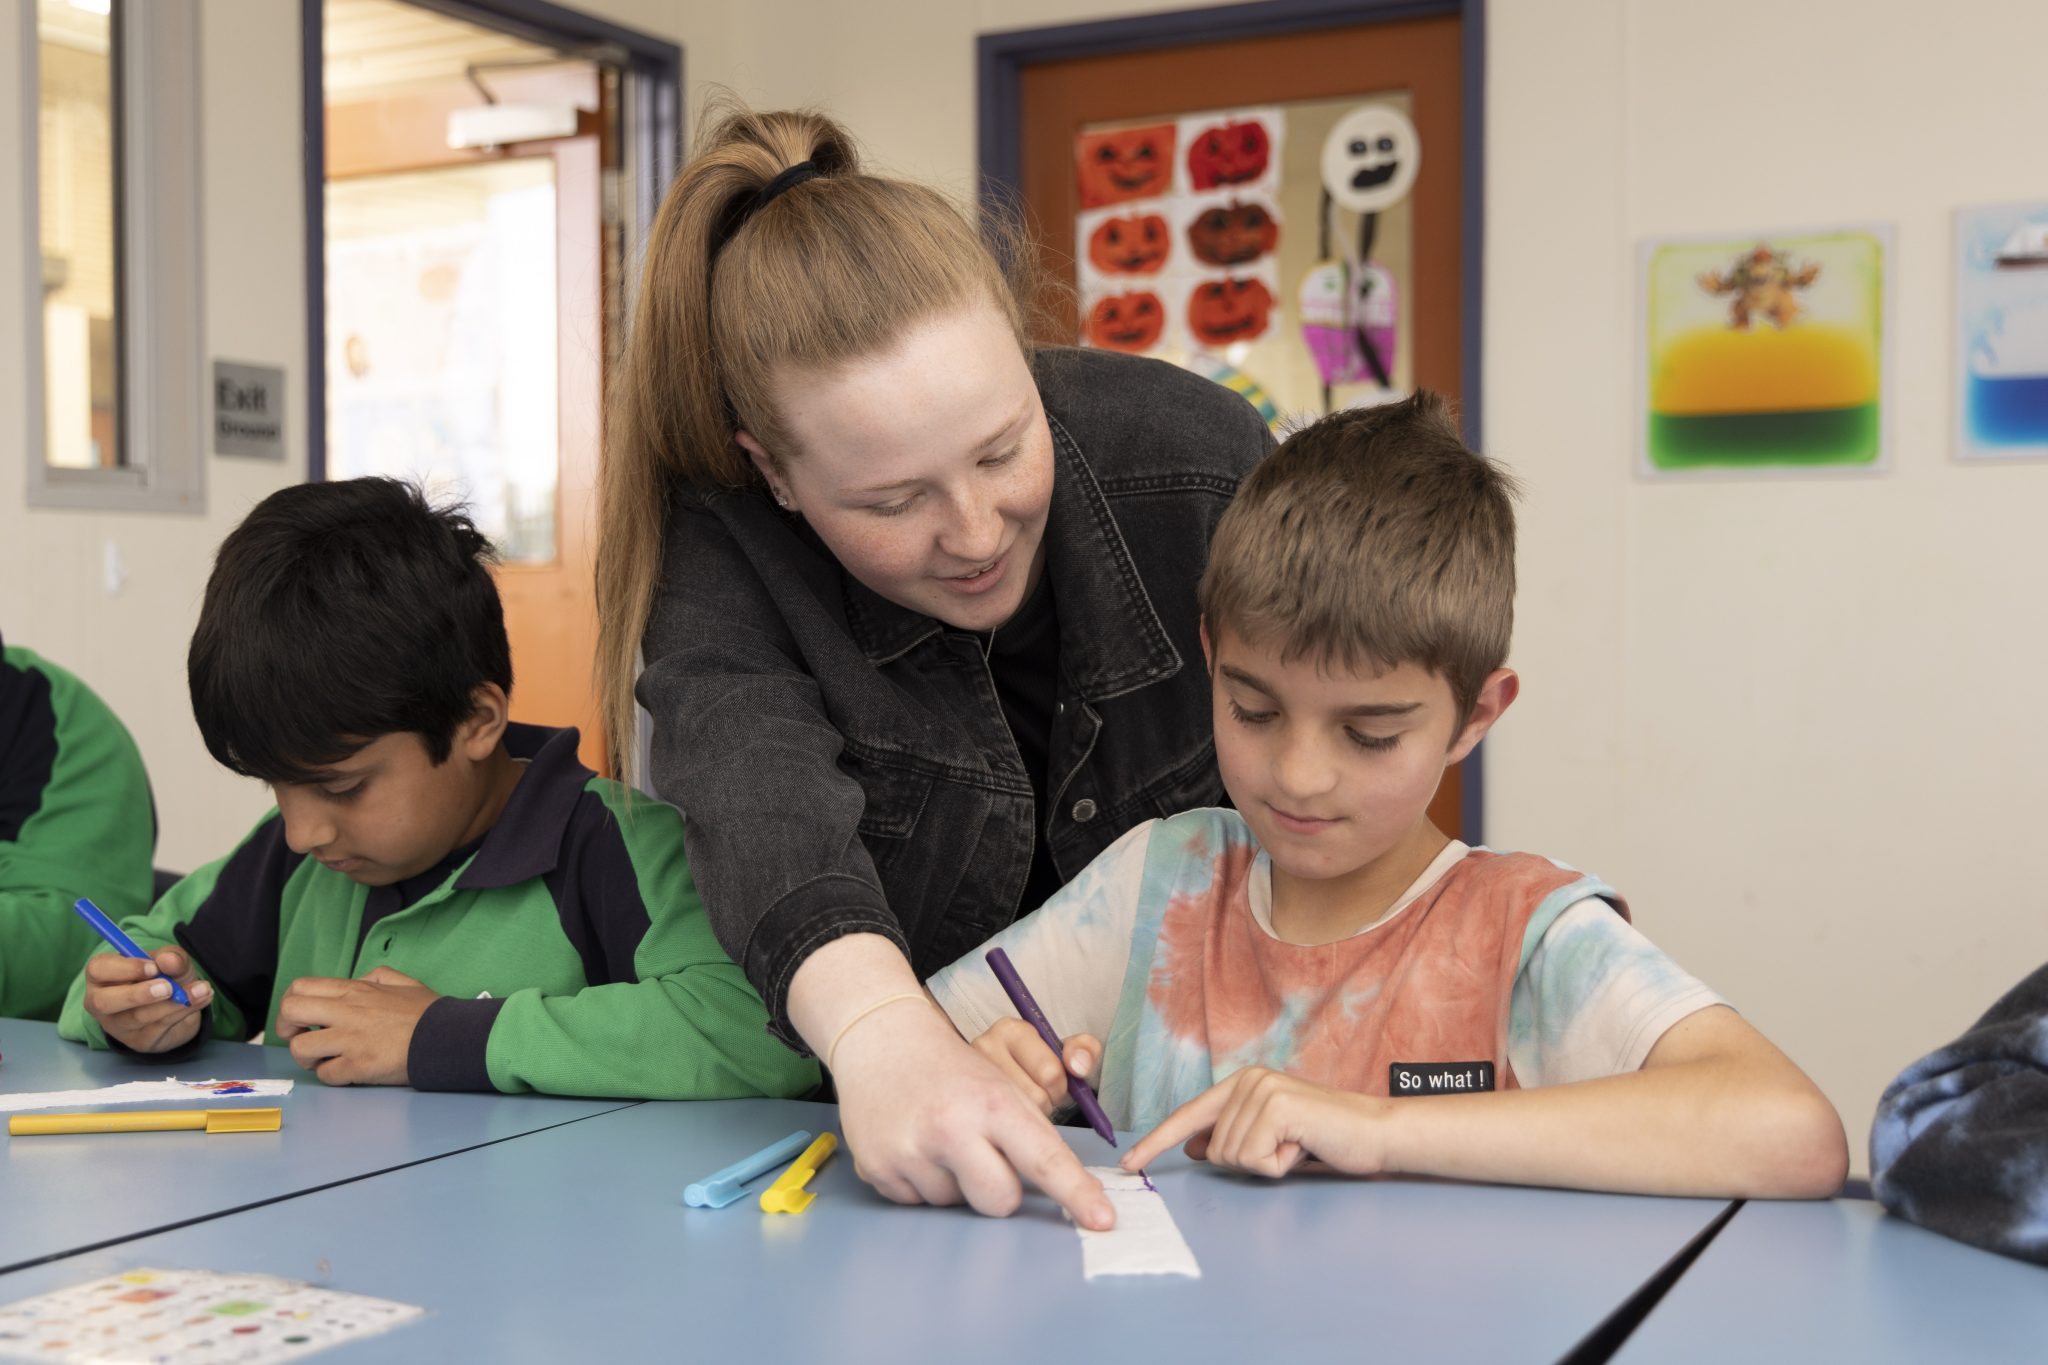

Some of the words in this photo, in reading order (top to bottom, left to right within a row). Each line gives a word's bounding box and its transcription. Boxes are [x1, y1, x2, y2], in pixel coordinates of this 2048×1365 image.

[217, 378, 267, 410] Exit
[1399, 1071, 1421, 1089] So
[1428, 1070, 1473, 1088] what
[1479, 1069, 1484, 1087] !
